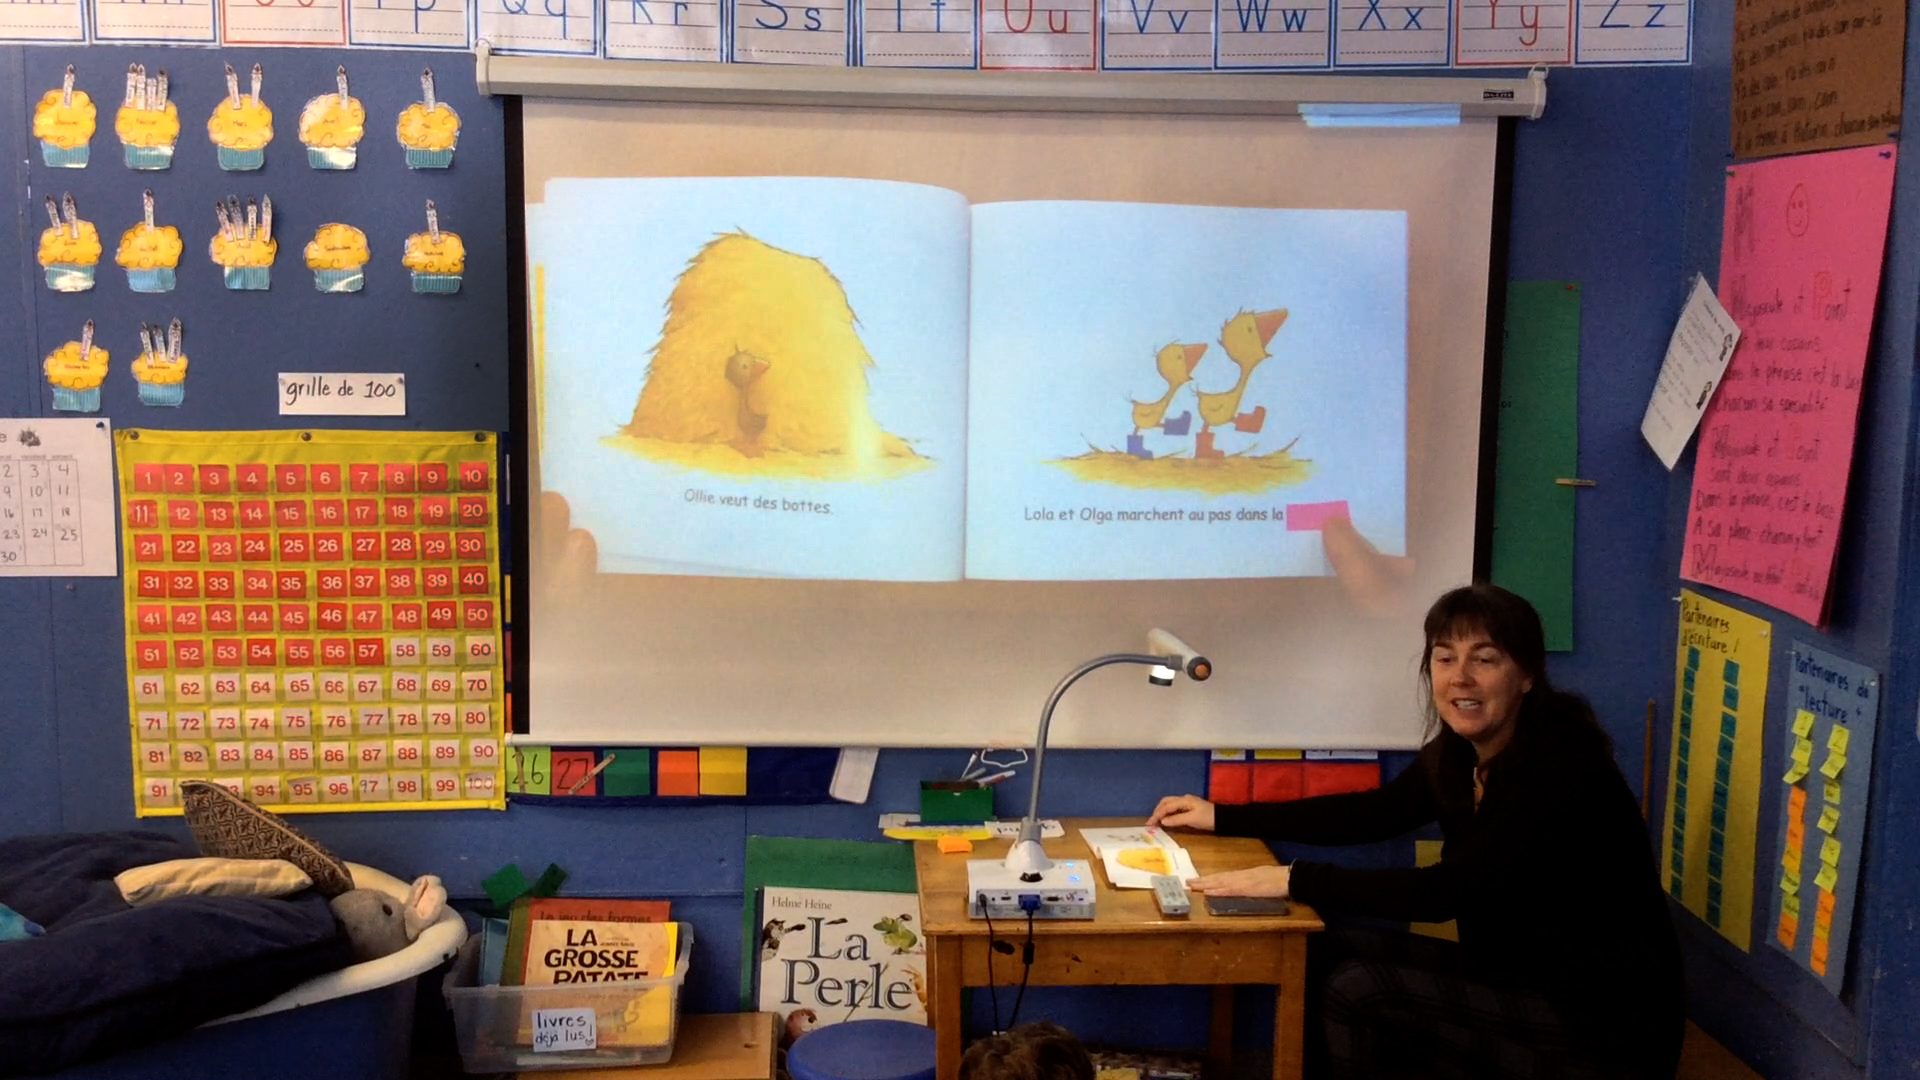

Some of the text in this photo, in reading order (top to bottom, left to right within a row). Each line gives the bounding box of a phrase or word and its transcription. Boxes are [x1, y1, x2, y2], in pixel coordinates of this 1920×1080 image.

[674, 2, 688, 26] r
[804, 7, 822, 31] s
[1004, 0, 1068, 33] U u
[1131, 0, 1189, 34] V v
[1237, 0, 1308, 33] W w
[1403, 7, 1423, 31] x
[1645, 4, 1666, 28] z
[1519, 5, 1541, 46] y
[285, 375, 396, 406] grille de 100
[3, 464, 70, 478] 2 3 4
[174, 472, 184, 485] 2
[209, 472, 220, 485] 3
[246, 472, 258, 484] 4
[285, 471, 297, 485] 5
[319, 471, 331, 484] 6
[359, 471, 369, 484] 7
[394, 471, 405, 484] 8
[427, 470, 438, 483] 9
[465, 469, 482, 482] 10
[3, 485, 70, 499] 9 10 11
[684, 488, 834, 516] Ollie veut des bottes.
[32, 508, 43, 518] 17
[62, 507, 71, 517] 18
[135, 504, 483, 522] 11 12 13 14 15 16 17 18 19 20
[1024, 506, 1284, 526] Lola et Olga marchent au pas dans la
[4, 528, 78, 541] 23 24 25
[141, 537, 481, 555] 21 22 23 24 25 26 27 28 29 30
[0, 551, 17, 563] 30
[144, 607, 488, 625] 41 42 43 44 45 46 47 48 49 50
[144, 643, 492, 662] 51 52 53 54 55 56 57 58 59 60
[142, 678, 488, 696] 61 62 63 64 65 66 67 68 69 70
[151, 784, 167, 799] 91
[254, 785, 275, 797] 94
[292, 783, 313, 796] 95
[328, 782, 349, 796] 96
[359, 779, 379, 794] 97
[397, 780, 417, 793] 98
[435, 779, 456, 793] 99
[467, 777, 494, 791] 100
[772, 895, 833, 911] Helme Heine
[566, 929, 598, 947] LA
[807, 916, 871, 961] La
[544, 949, 639, 969] GROSSE
[780, 958, 913, 1012] Perle
[536, 1011, 587, 1030] livres
